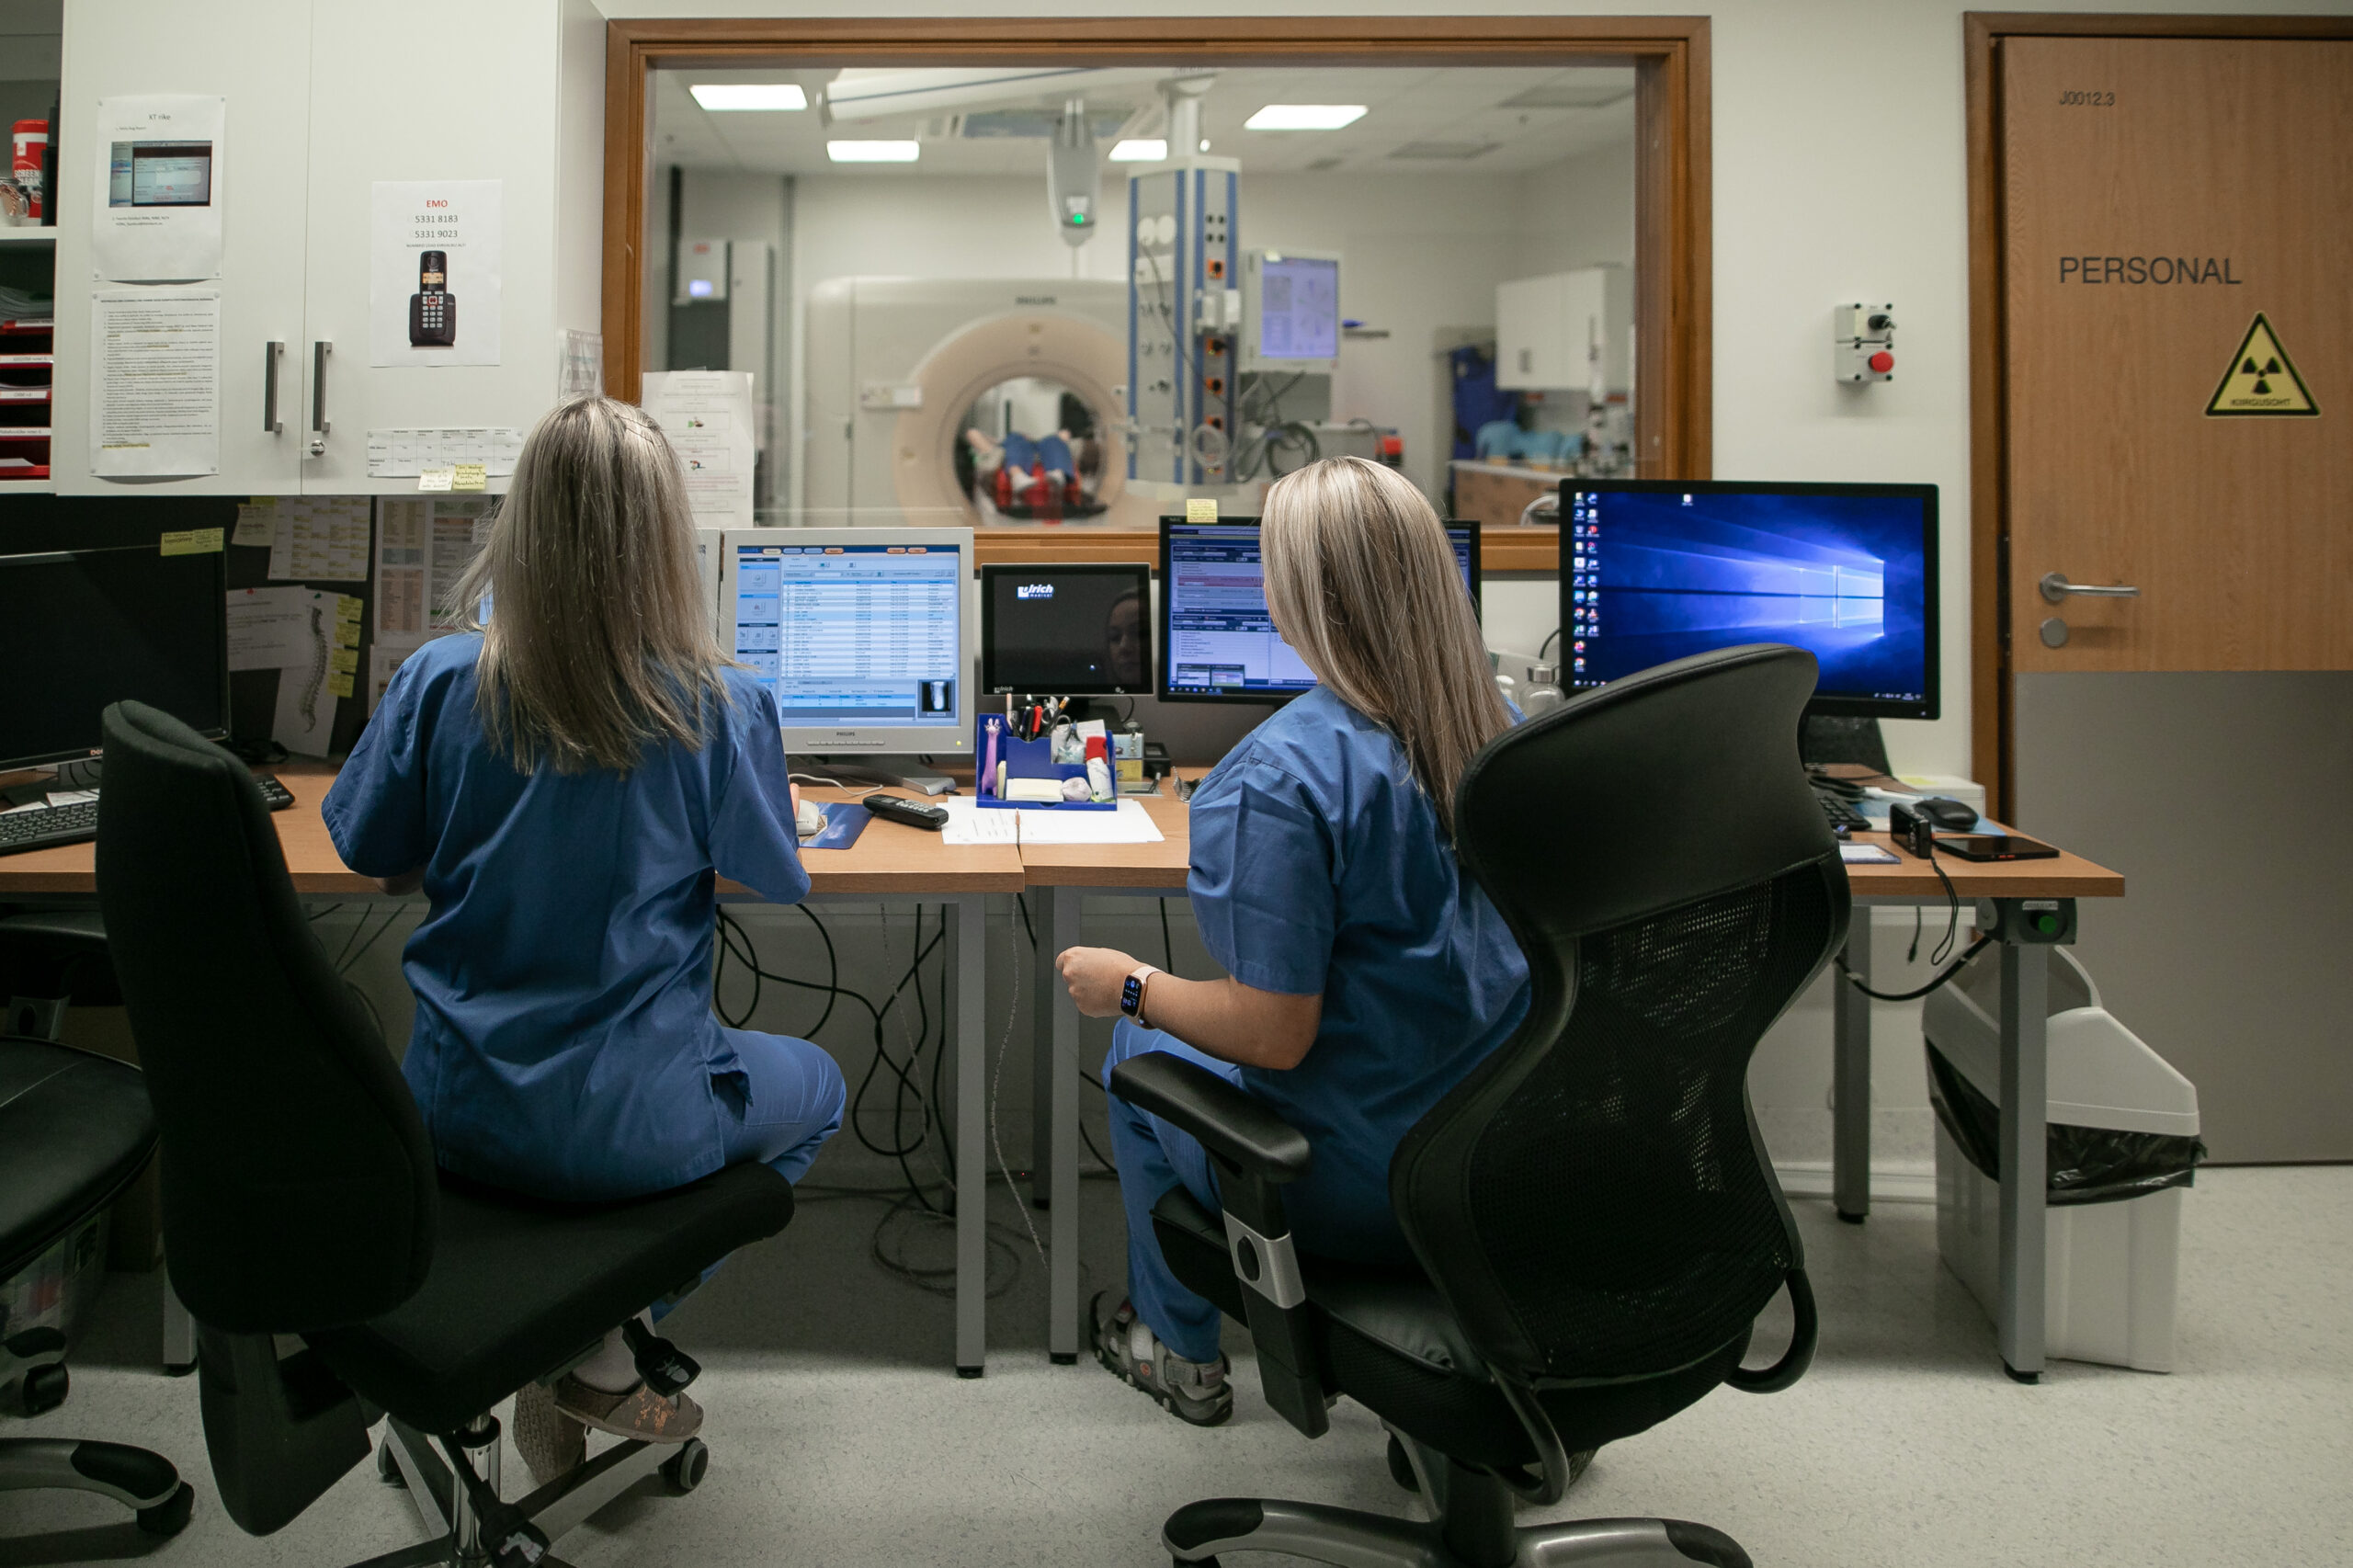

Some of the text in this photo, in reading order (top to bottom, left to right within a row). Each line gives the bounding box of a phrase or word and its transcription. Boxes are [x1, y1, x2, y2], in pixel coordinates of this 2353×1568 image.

[426, 199, 448, 208] EMO
[415, 215, 459, 223] 5331 8183
[415, 230, 458, 238] 5331 9023
[2059, 256, 2243, 285] PERSONAL
[1017, 584, 1054, 598] ulrich
